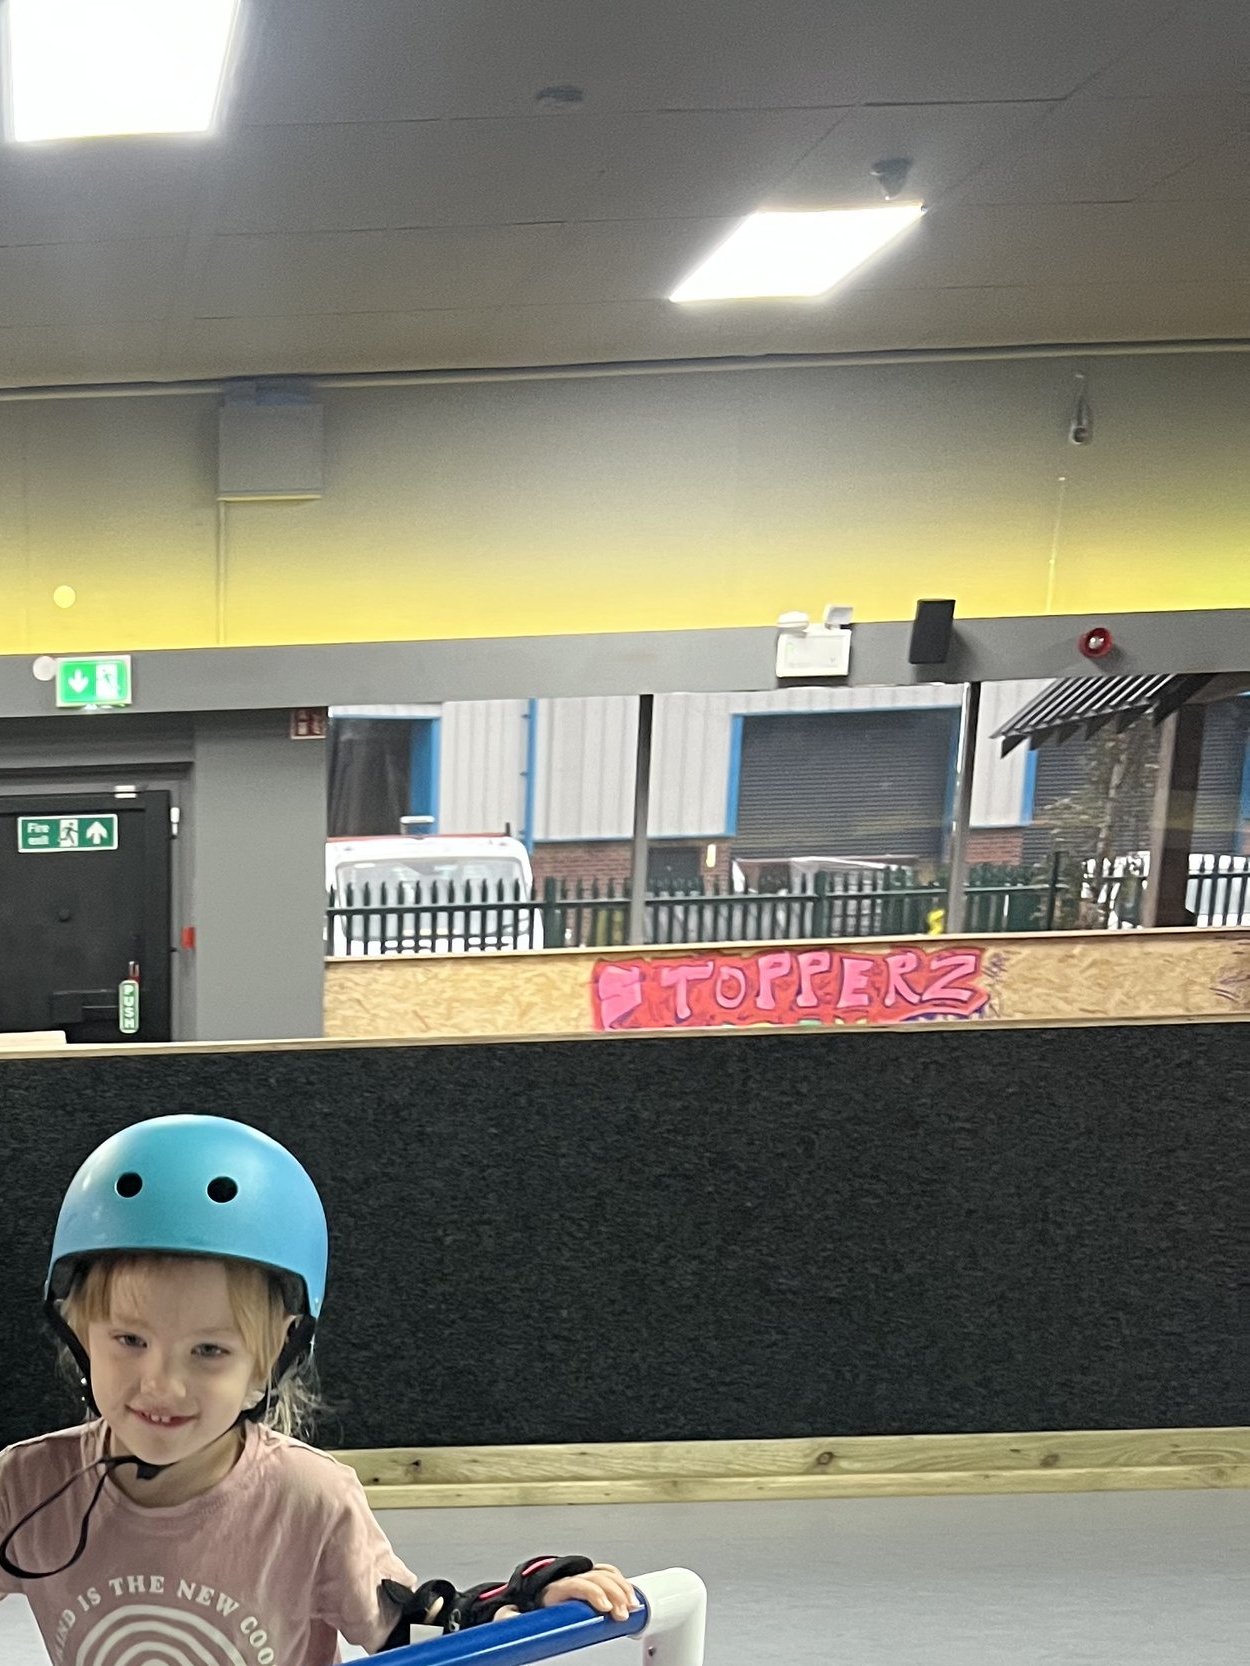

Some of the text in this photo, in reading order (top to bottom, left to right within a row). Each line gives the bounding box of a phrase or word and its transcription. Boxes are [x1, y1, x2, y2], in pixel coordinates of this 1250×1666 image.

[27, 822, 50, 833] Fire
[123, 984, 135, 1028] PUSH
[77, 1587, 101, 1612] IS
[108, 1574, 165, 1597] THE
[176, 1579, 240, 1617] NEW
